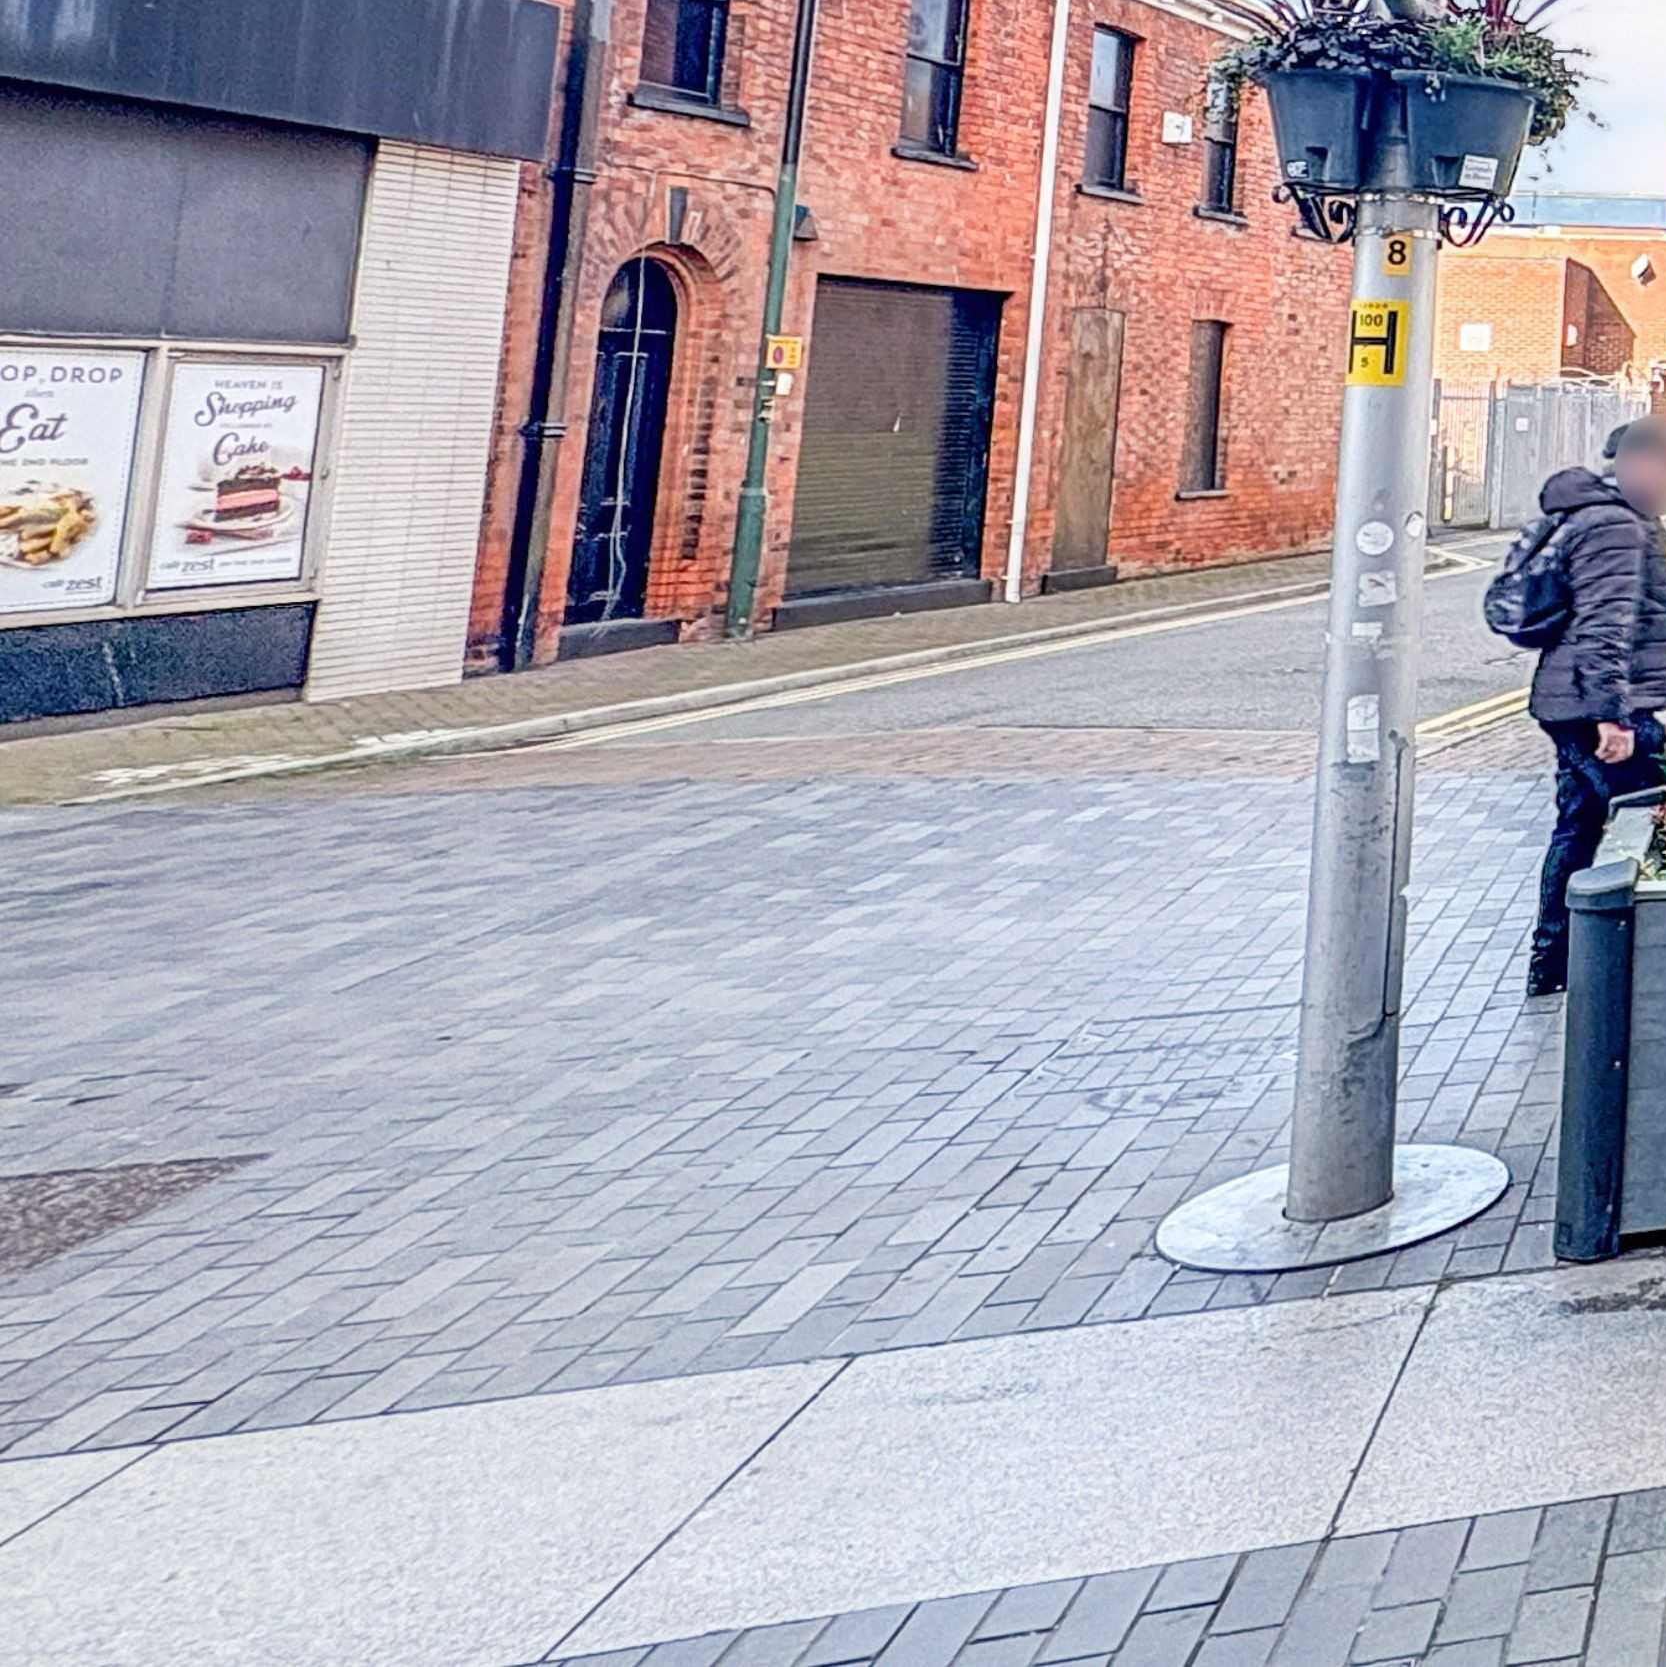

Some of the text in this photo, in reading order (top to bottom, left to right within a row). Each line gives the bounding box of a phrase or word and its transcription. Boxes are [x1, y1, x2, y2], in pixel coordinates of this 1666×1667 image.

[1387, 239, 1407, 266] 8
[1359, 313, 1384, 327] 100
[1348, 310, 1399, 375] H
[50, 366, 123, 384] DROP
[194, 391, 296, 427] Shopping
[0, 402, 68, 453] Eat
[213, 432, 270, 466] Cake
